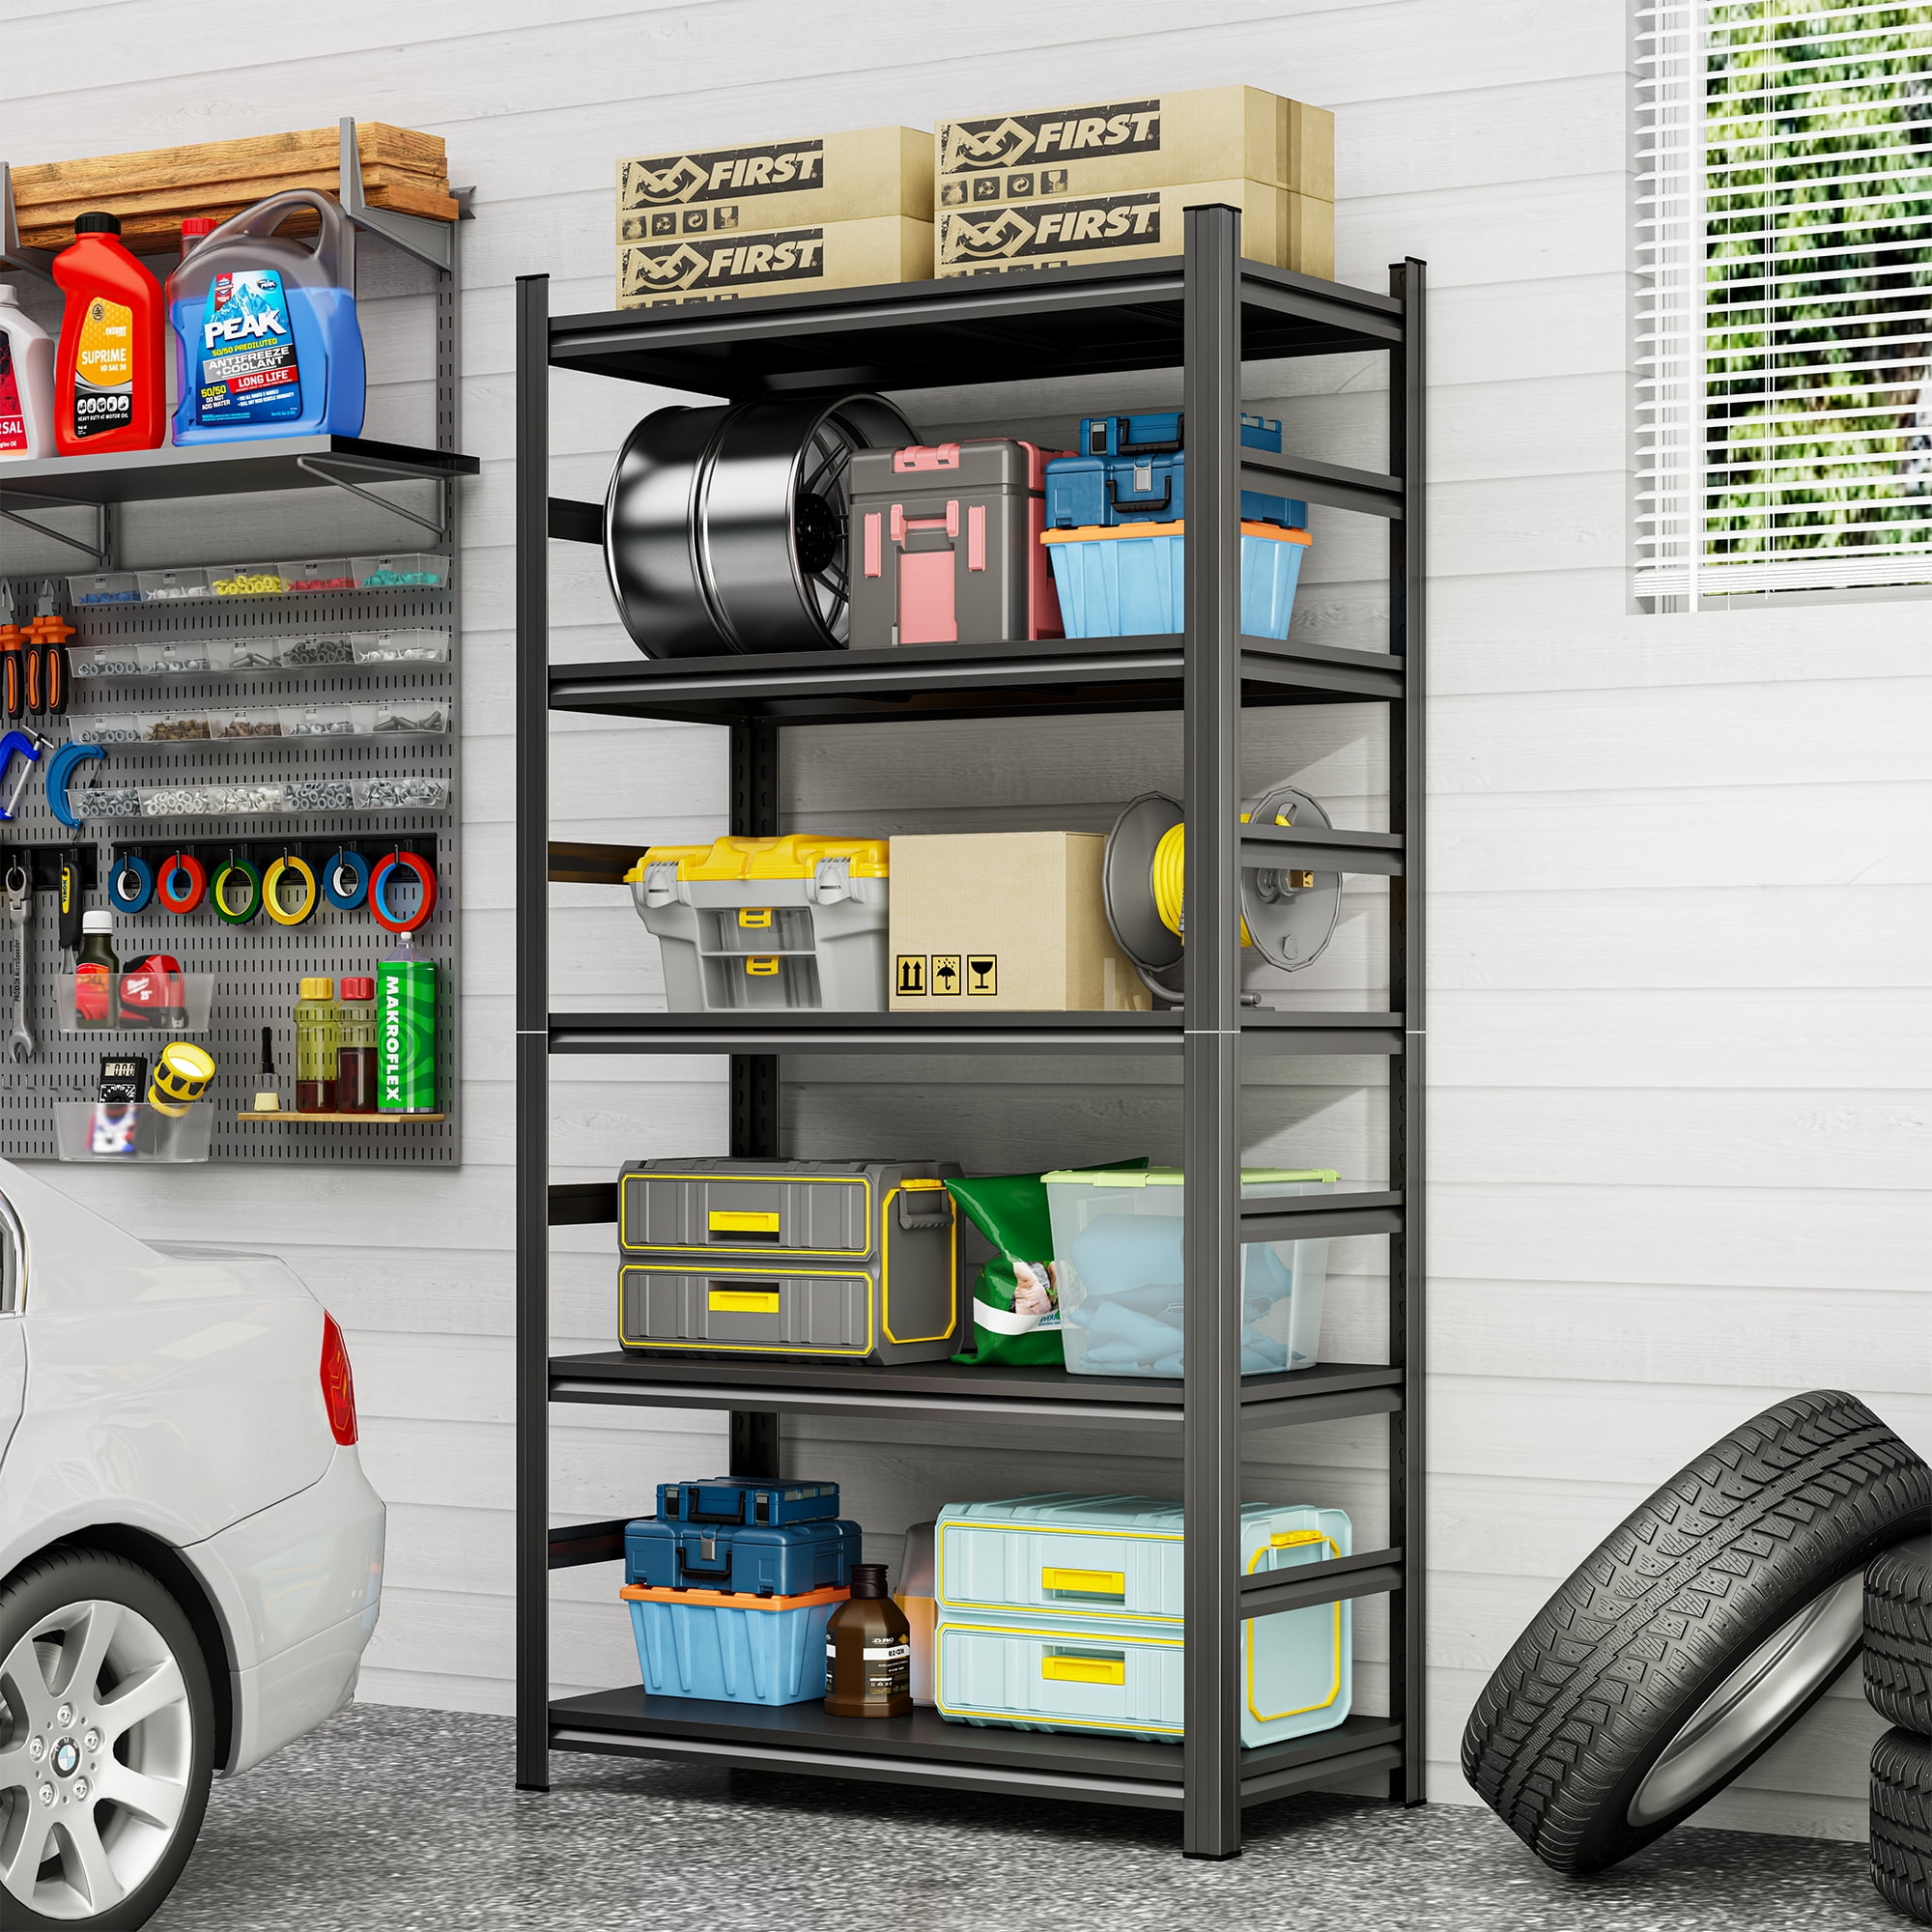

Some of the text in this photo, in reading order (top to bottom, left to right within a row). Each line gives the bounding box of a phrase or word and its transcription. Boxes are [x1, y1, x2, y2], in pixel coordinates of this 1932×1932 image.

[1035, 110, 1159, 154] FIRST
[708, 150, 823, 190] FIRST
[1035, 203, 1159, 244] FIRST
[708, 239, 823, 277] FIRST
[204, 309, 287, 349] PEAK
[81, 348, 127, 366] SUPRIME
[209, 346, 290, 370] ANTIFREEZE
[213, 338, 277, 356] 50/50 PREDILUTED
[200, 384, 227, 398] 50/50
[238, 374, 264, 388] LONG
[266, 369, 289, 383] LIFE
[202, 399, 231, 411] ADD WATER
[386, 975, 400, 1102] MAKROFLEX
